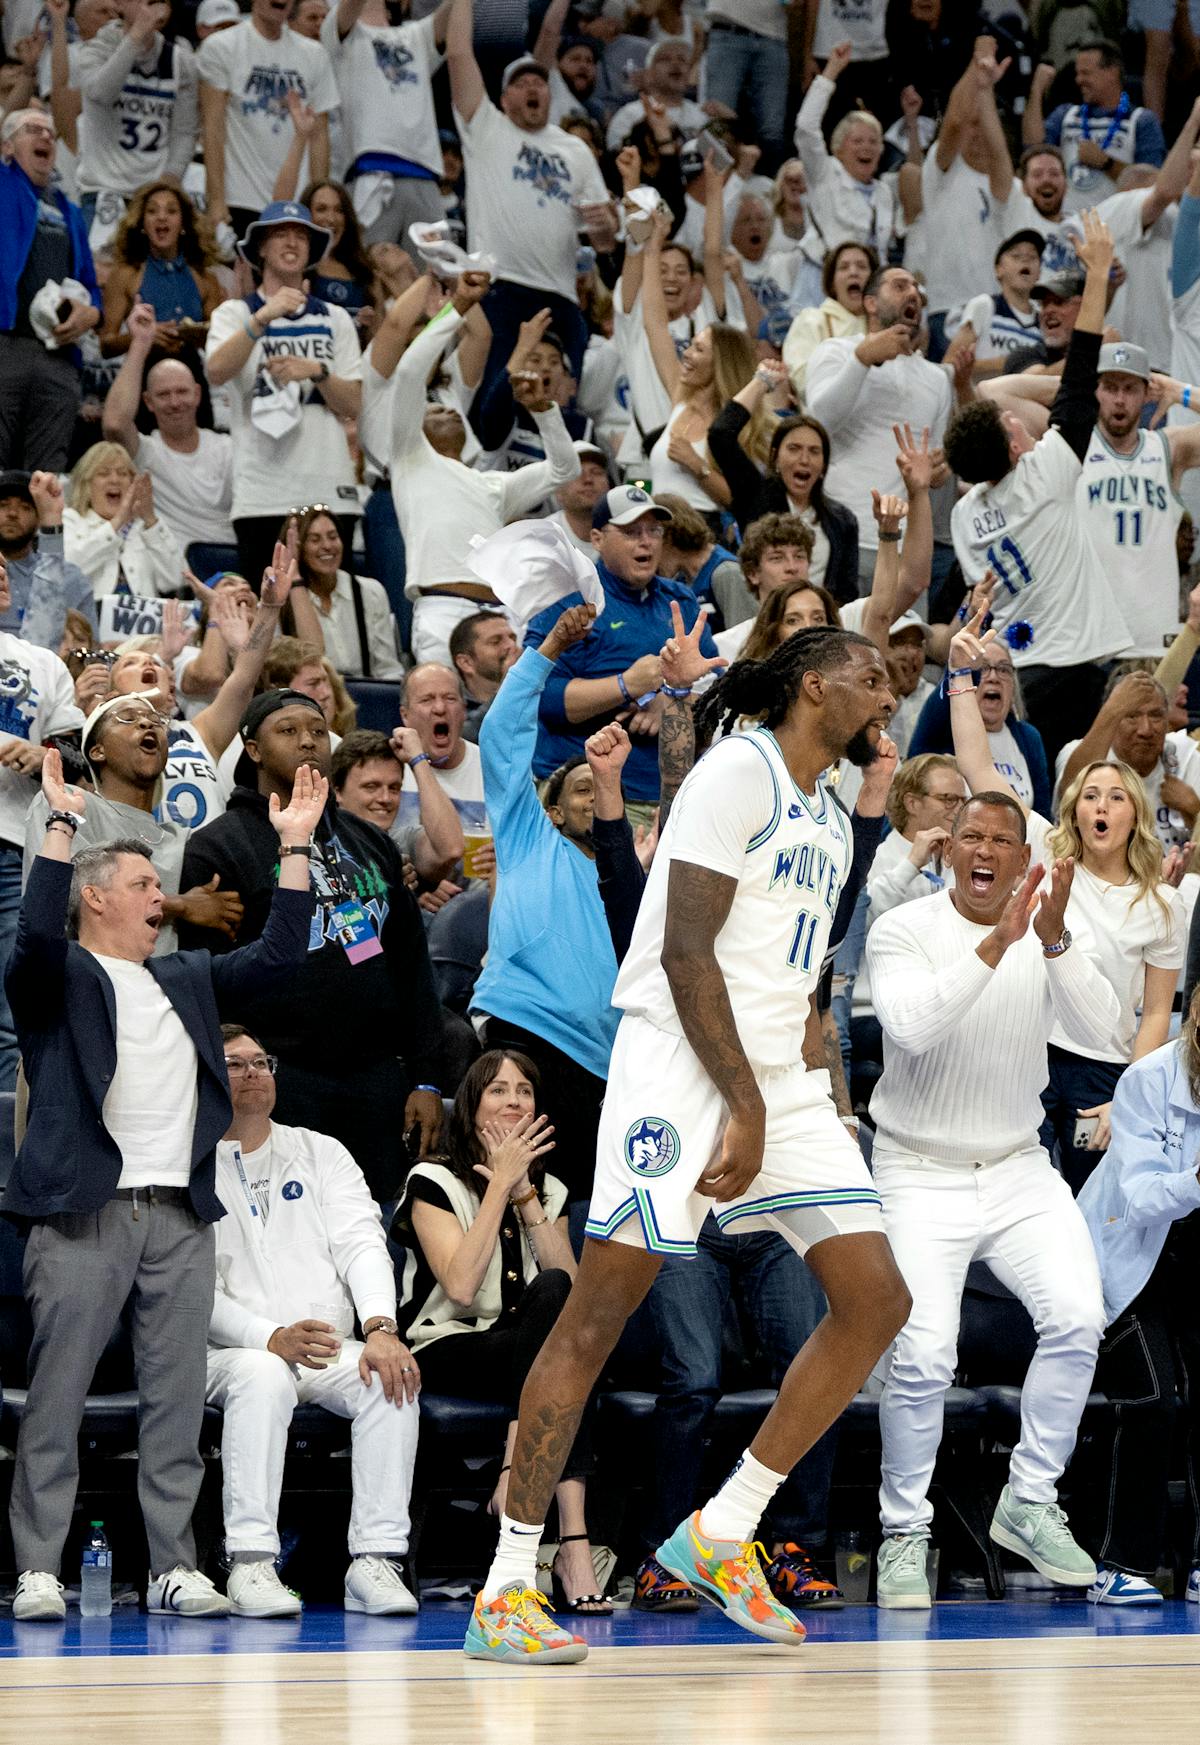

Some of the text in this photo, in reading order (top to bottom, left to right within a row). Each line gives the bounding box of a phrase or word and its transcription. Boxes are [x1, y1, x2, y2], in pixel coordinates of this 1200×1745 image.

[119, 117, 161, 152] 32
[262, 340, 334, 360] WOLVES
[1087, 475, 1167, 511] WOLVES
[1114, 509, 1142, 545] 11
[985, 533, 1036, 597] 11
[768, 842, 842, 920] WOLVE
[786, 908, 819, 975] 11
